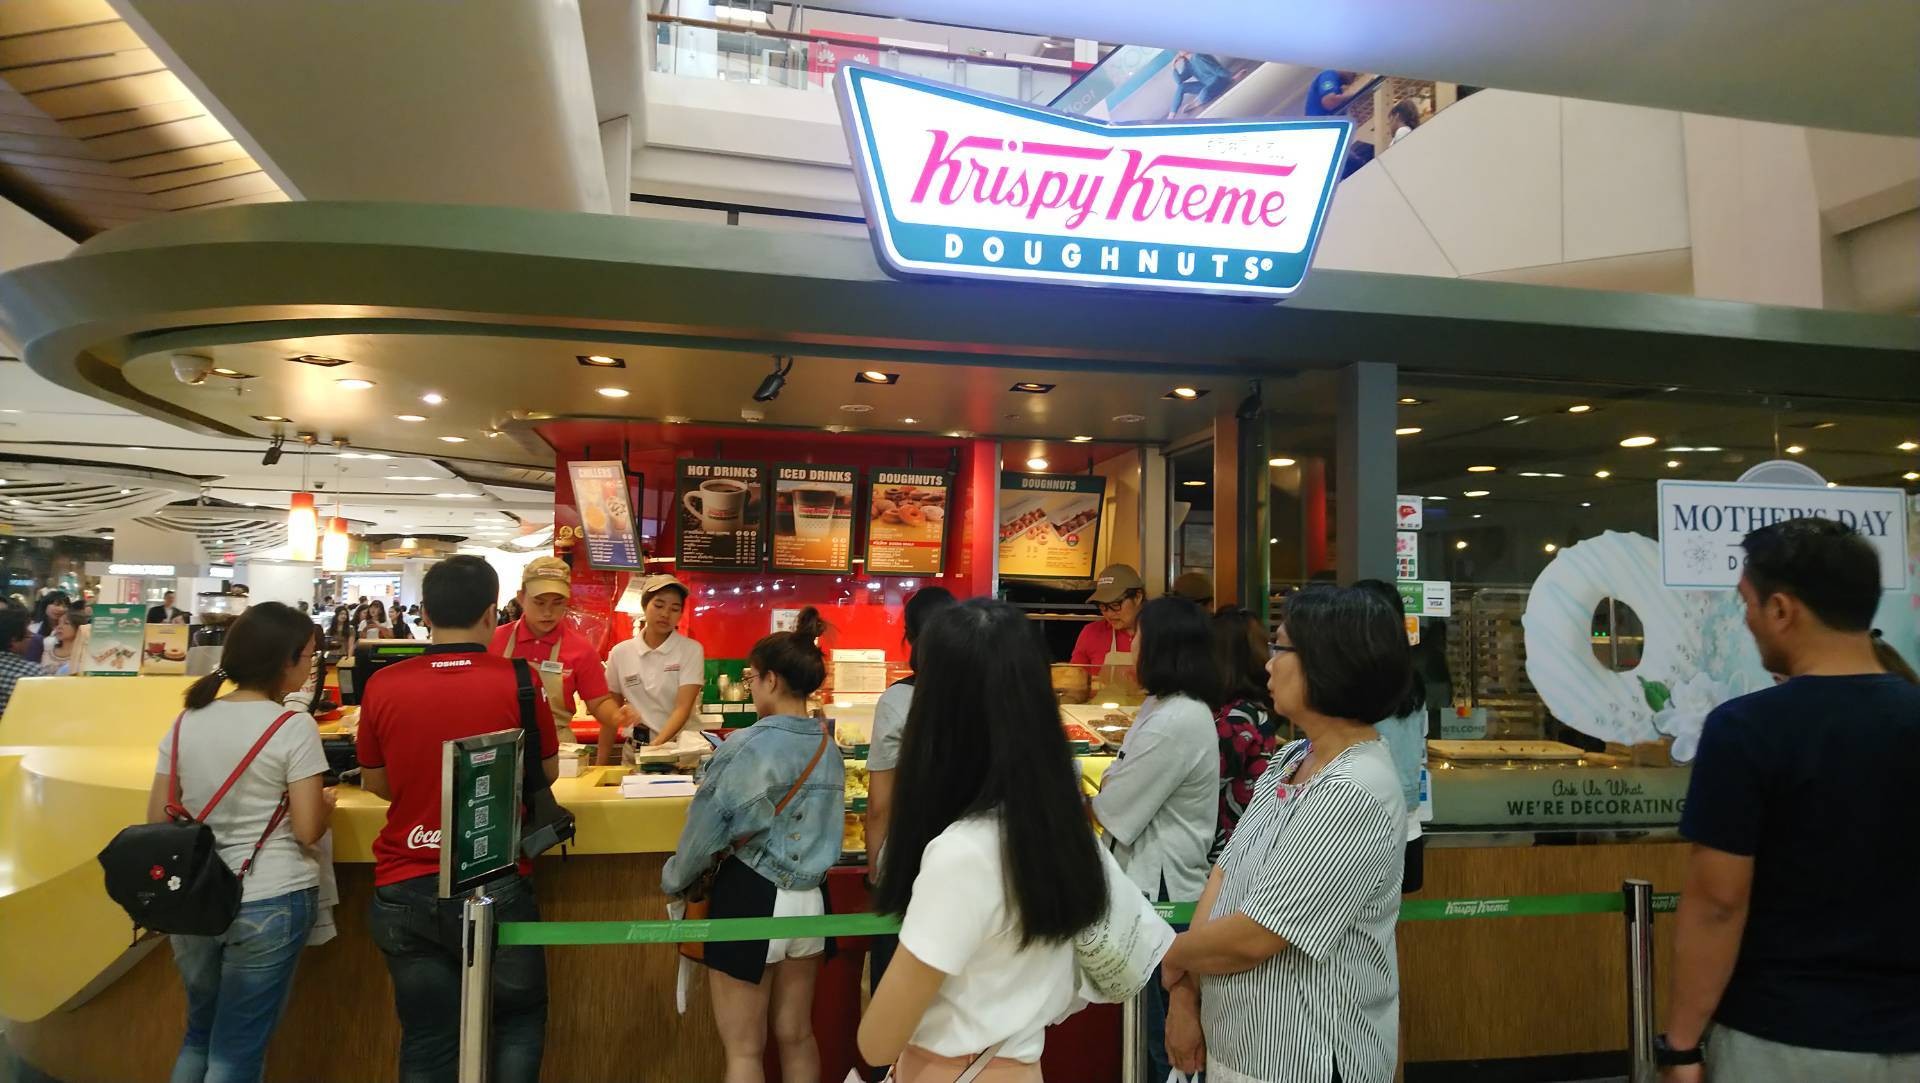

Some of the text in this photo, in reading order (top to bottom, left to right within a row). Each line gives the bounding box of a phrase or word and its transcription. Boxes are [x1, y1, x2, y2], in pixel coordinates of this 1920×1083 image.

[910, 129, 1298, 230] Krispy Kreme
[688, 465, 758, 478] HOT DRINKS
[780, 468, 852, 482] ICED DRINKS
[878, 472, 943, 486] DOUGHNUTS
[1021, 478, 1077, 491] DOUGHNUTS
[1836, 510, 1893, 537] DAY
[431, 659, 472, 668] TOSHIBA
[1552, 779, 1643, 796] Ask Us What
[1507, 800, 1564, 816] WE'RE
